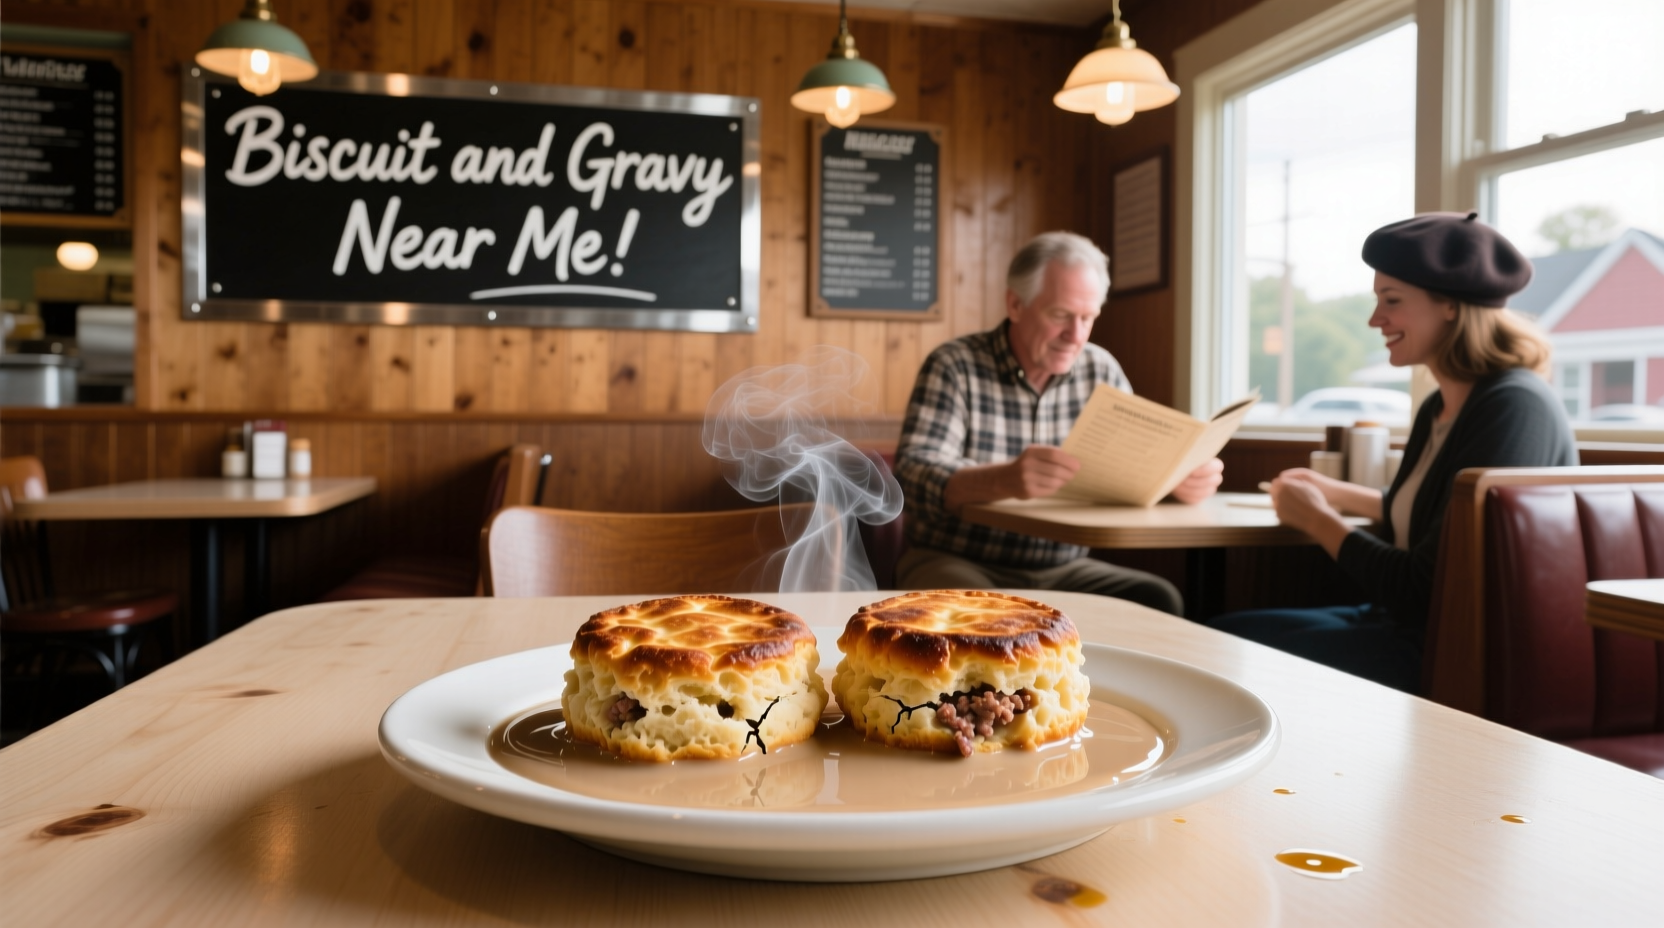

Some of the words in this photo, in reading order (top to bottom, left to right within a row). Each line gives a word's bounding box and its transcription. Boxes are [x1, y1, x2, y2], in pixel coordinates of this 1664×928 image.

[225, 105, 442, 186] Biscuit
[450, 122, 556, 187] and
[566, 122, 734, 228] Gravy
[332, 195, 497, 276] Near
[507, 205, 641, 282] Me!
